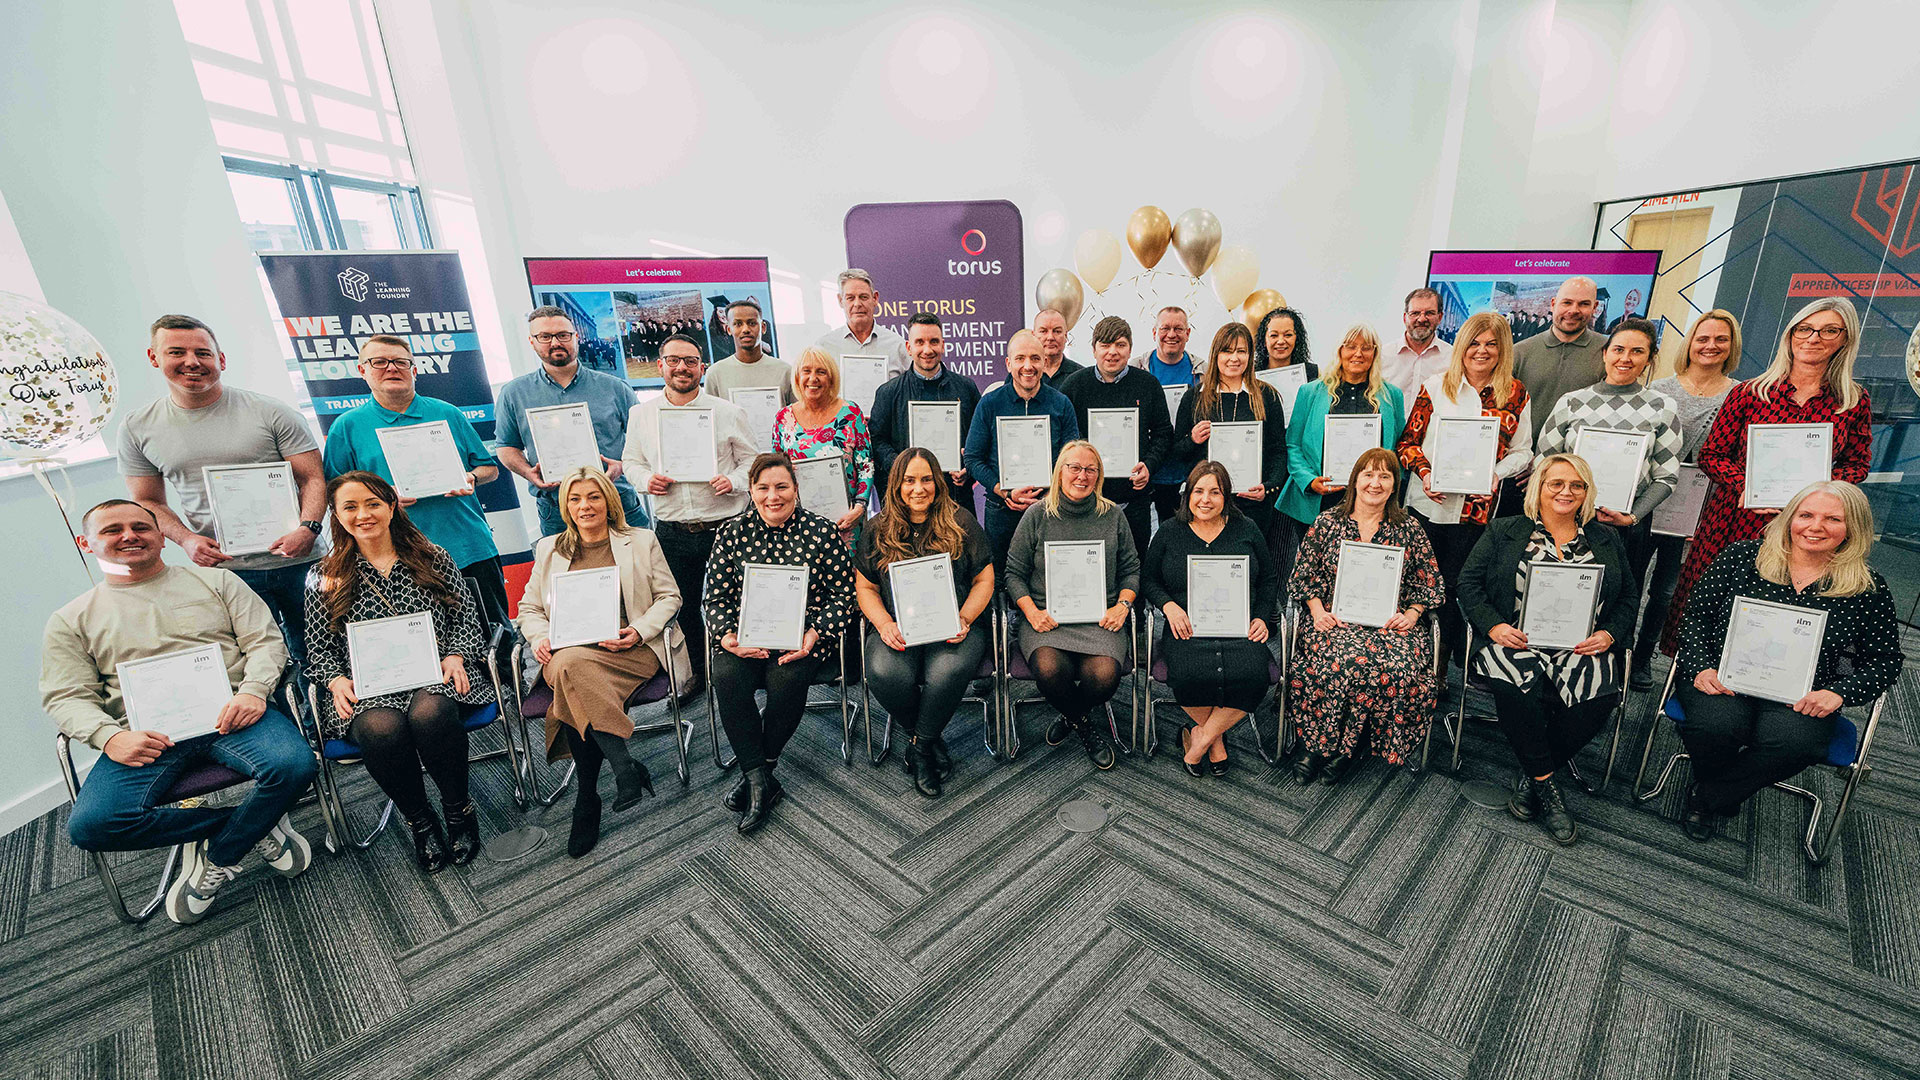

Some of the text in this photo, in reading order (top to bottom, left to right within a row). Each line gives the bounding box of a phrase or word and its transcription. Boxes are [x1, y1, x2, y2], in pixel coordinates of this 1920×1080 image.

[948, 259, 1002, 276] torus
[1534, 259, 1571, 268] celebrate
[645, 268, 682, 277] celebrate
[873, 299, 976, 318] ONE TORUS
[287, 311, 473, 337] WE ARE THE
[1796, 618, 1812, 627] ilm
[193, 656, 210, 664] ilm
